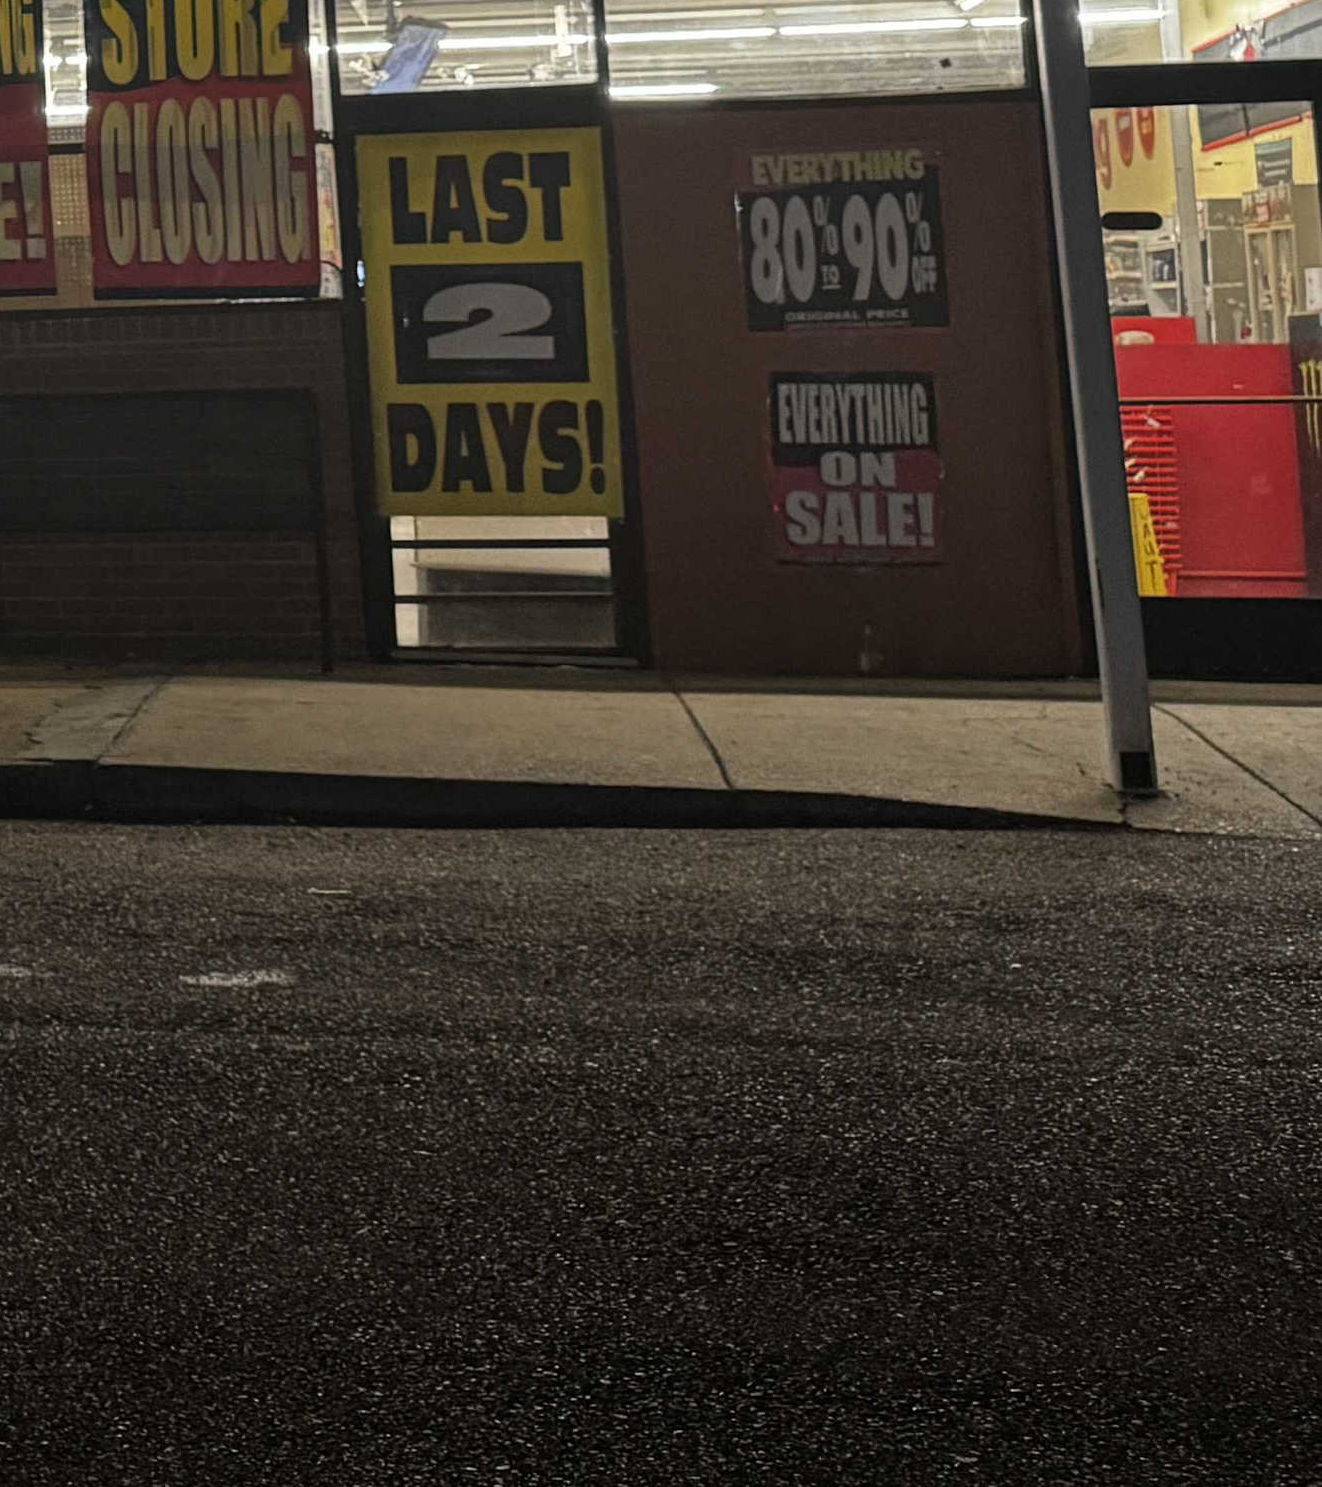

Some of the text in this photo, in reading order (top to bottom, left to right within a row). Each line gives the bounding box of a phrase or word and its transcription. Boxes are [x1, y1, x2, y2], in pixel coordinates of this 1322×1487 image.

[99, 94, 310, 266] CLOSING
[751, 149, 924, 185] EVERYTHING
[388, 152, 571, 245] LAST
[821, 264, 841, 285] TO
[422, 282, 555, 360] 2
[866, 307, 910, 319] PRICE
[777, 382, 930, 445] EVERYTHING
[387, 399, 606, 495] DAYS!
[820, 450, 897, 488] ON
[785, 490, 935, 546] SALE!
